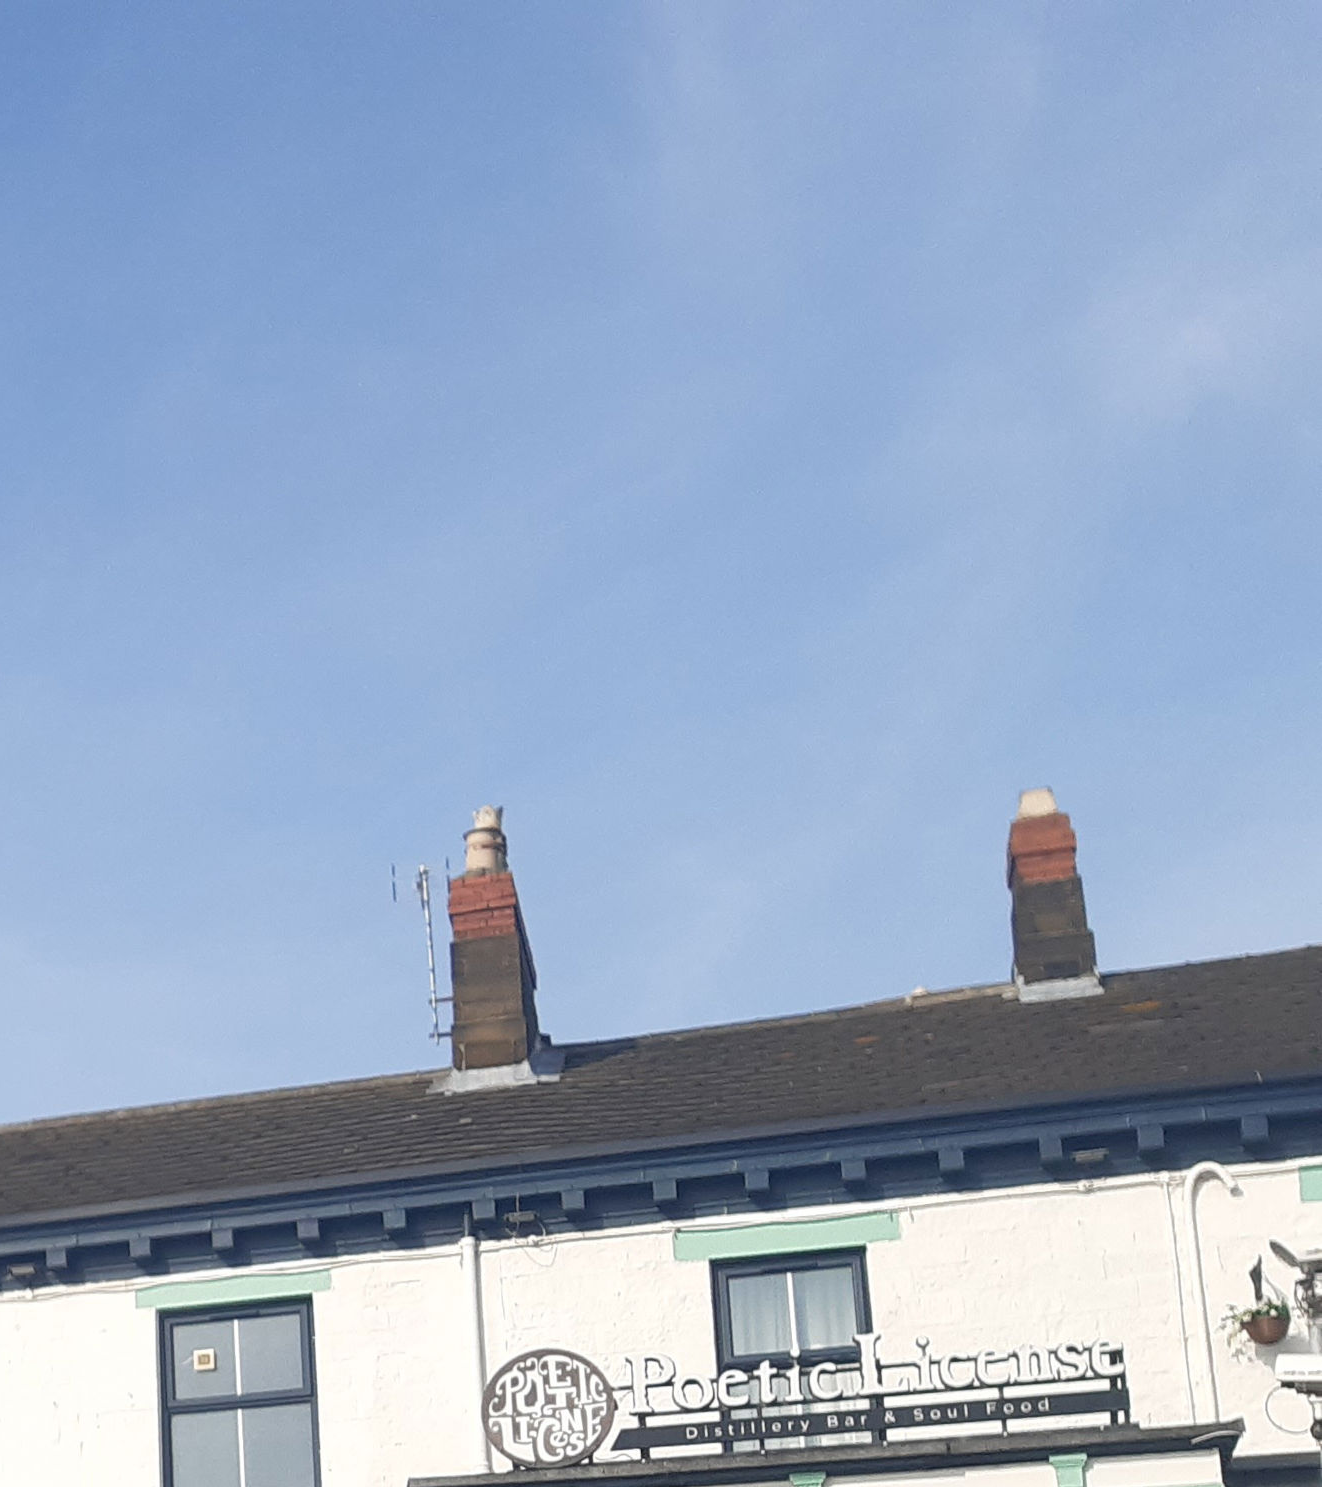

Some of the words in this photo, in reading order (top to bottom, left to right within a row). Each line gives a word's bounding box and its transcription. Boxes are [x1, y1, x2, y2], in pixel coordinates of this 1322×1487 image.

[624, 1345, 844, 1415] Poetic
[851, 1332, 1125, 1397] License
[685, 1417, 810, 1440] Distillery
[826, 1414, 868, 1429] Bar
[883, 1409, 897, 1423] &
[913, 1403, 970, 1421] Soul
[985, 1397, 1051, 1416] Food
